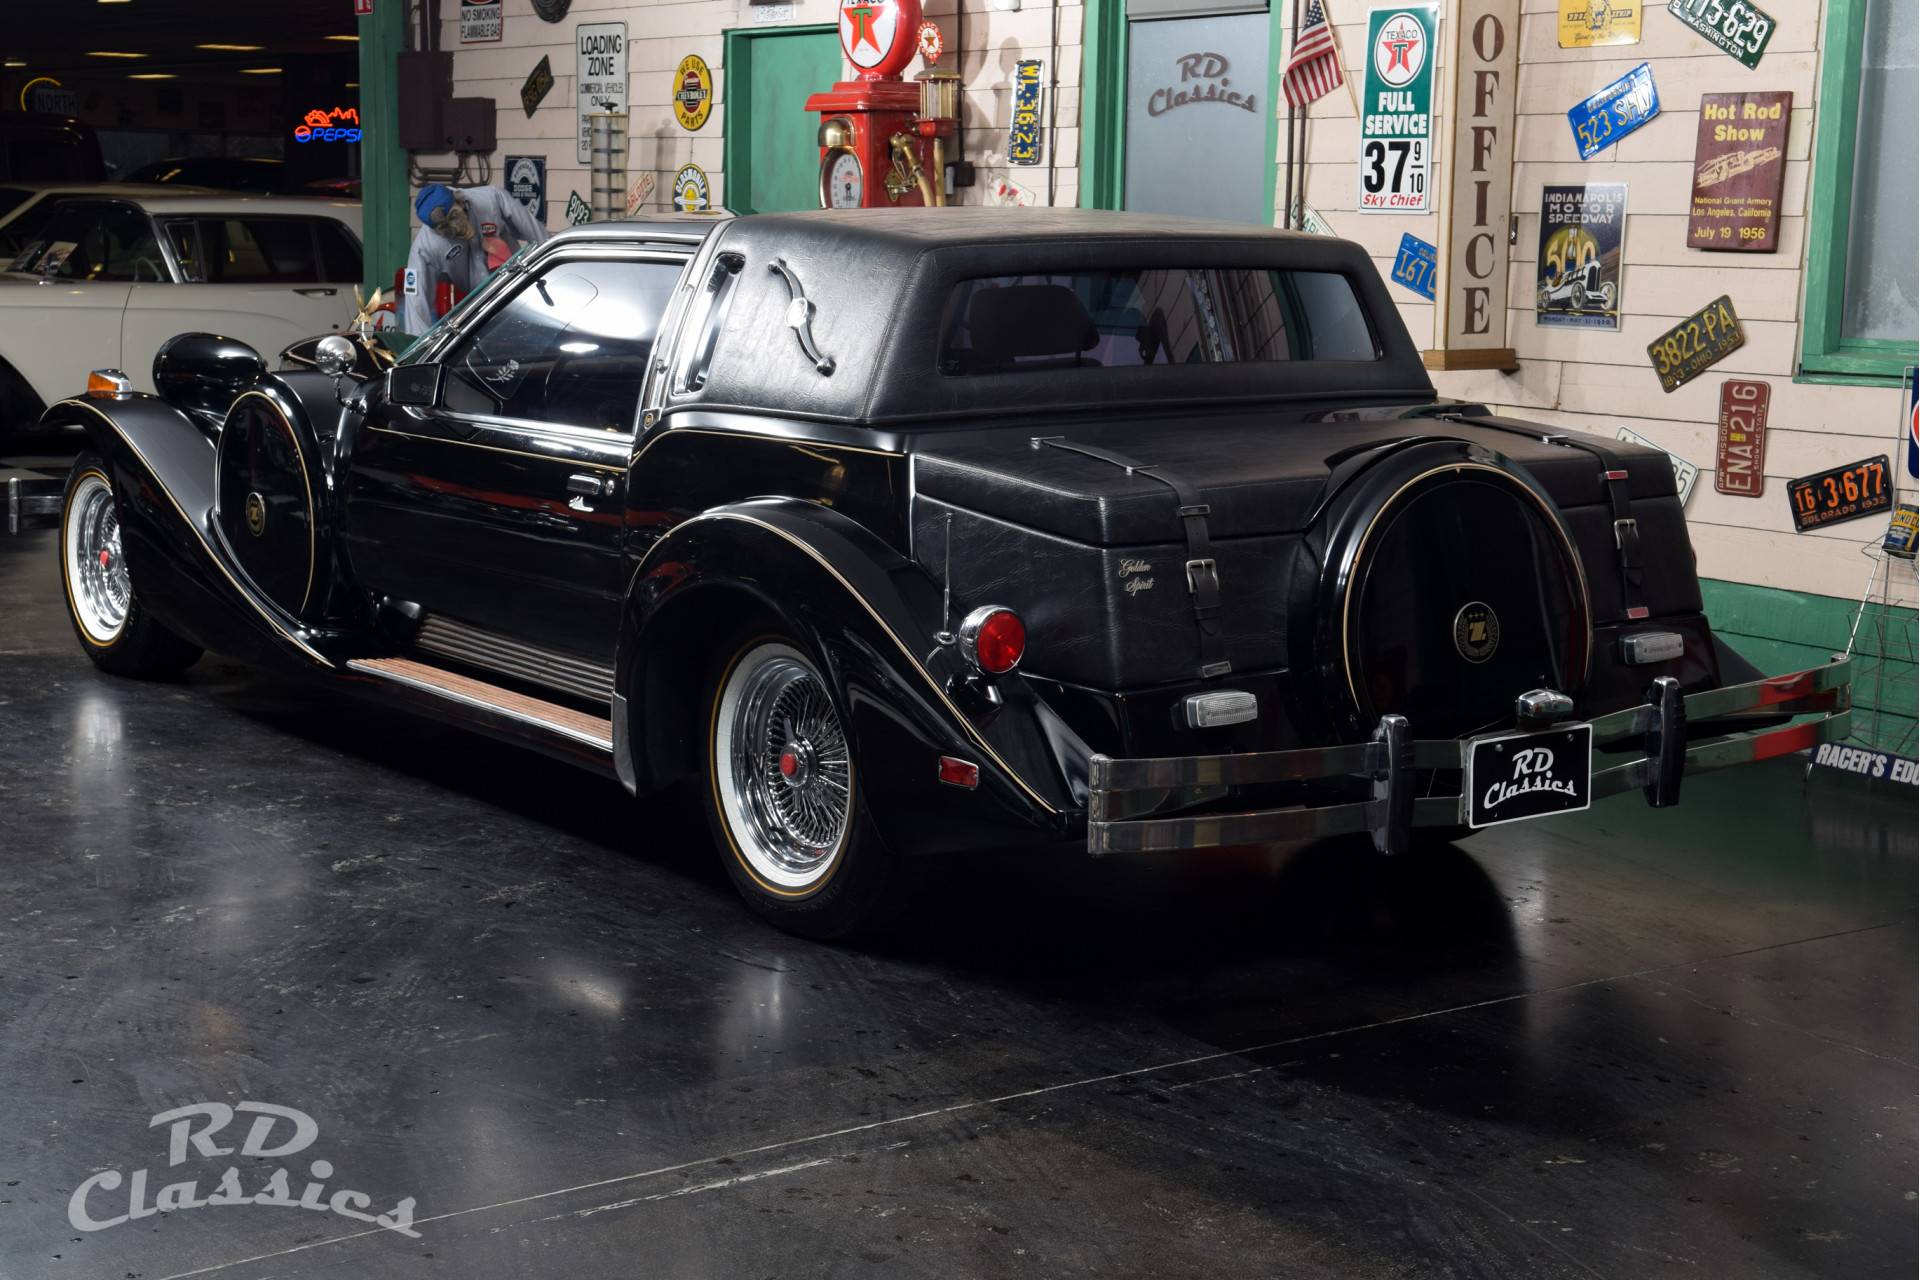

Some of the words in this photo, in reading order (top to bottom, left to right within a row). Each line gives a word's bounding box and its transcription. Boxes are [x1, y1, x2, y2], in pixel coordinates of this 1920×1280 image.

[580, 34, 622, 55] LOADING
[1386, 29, 1418, 40] TEXACO
[1688, 15, 1744, 58] WASHINGTON
[588, 56, 615, 76] ZONE
[1176, 52, 1230, 82] RD
[1147, 77, 1257, 117] Classics
[1378, 91, 1415, 112] FULL
[1705, 104, 1736, 120] Hot
[1744, 102, 1781, 120] Rod
[312, 127, 363, 142] PEPSI
[1364, 114, 1427, 135] SERVICE
[1577, 110, 1613, 149] 523
[1714, 125, 1765, 142] Show
[1364, 141, 1411, 193] 37
[1414, 141, 1422, 161] 9
[1461, 14, 1505, 335] OFFICE
[1410, 173, 1424, 193] 10
[1363, 194, 1387, 207] Sky
[1389, 193, 1424, 206] Chief
[1545, 193, 1623, 203] INDIANAPOLIS
[1695, 197, 1722, 205] National
[1747, 197, 1772, 207] Armory
[1549, 204, 1615, 213] MOTOR
[1693, 208, 1705, 217] Los
[1738, 207, 1772, 218] California
[1548, 214, 1615, 224] SPEEDWAY
[1694, 227, 1715, 241] July
[1720, 227, 1731, 239] 19
[1740, 227, 1766, 240] 1956
[1729, 385, 1759, 432] 216
[1720, 411, 1729, 460] MISSOURI
[1726, 445, 1753, 490] ENA
[1118, 559, 1152, 577] Golden
[1126, 577, 1155, 596] Spirit
[1511, 748, 1554, 780] RD
[1815, 743, 1888, 777] RACER'S
[1484, 770, 1577, 810] Classics
